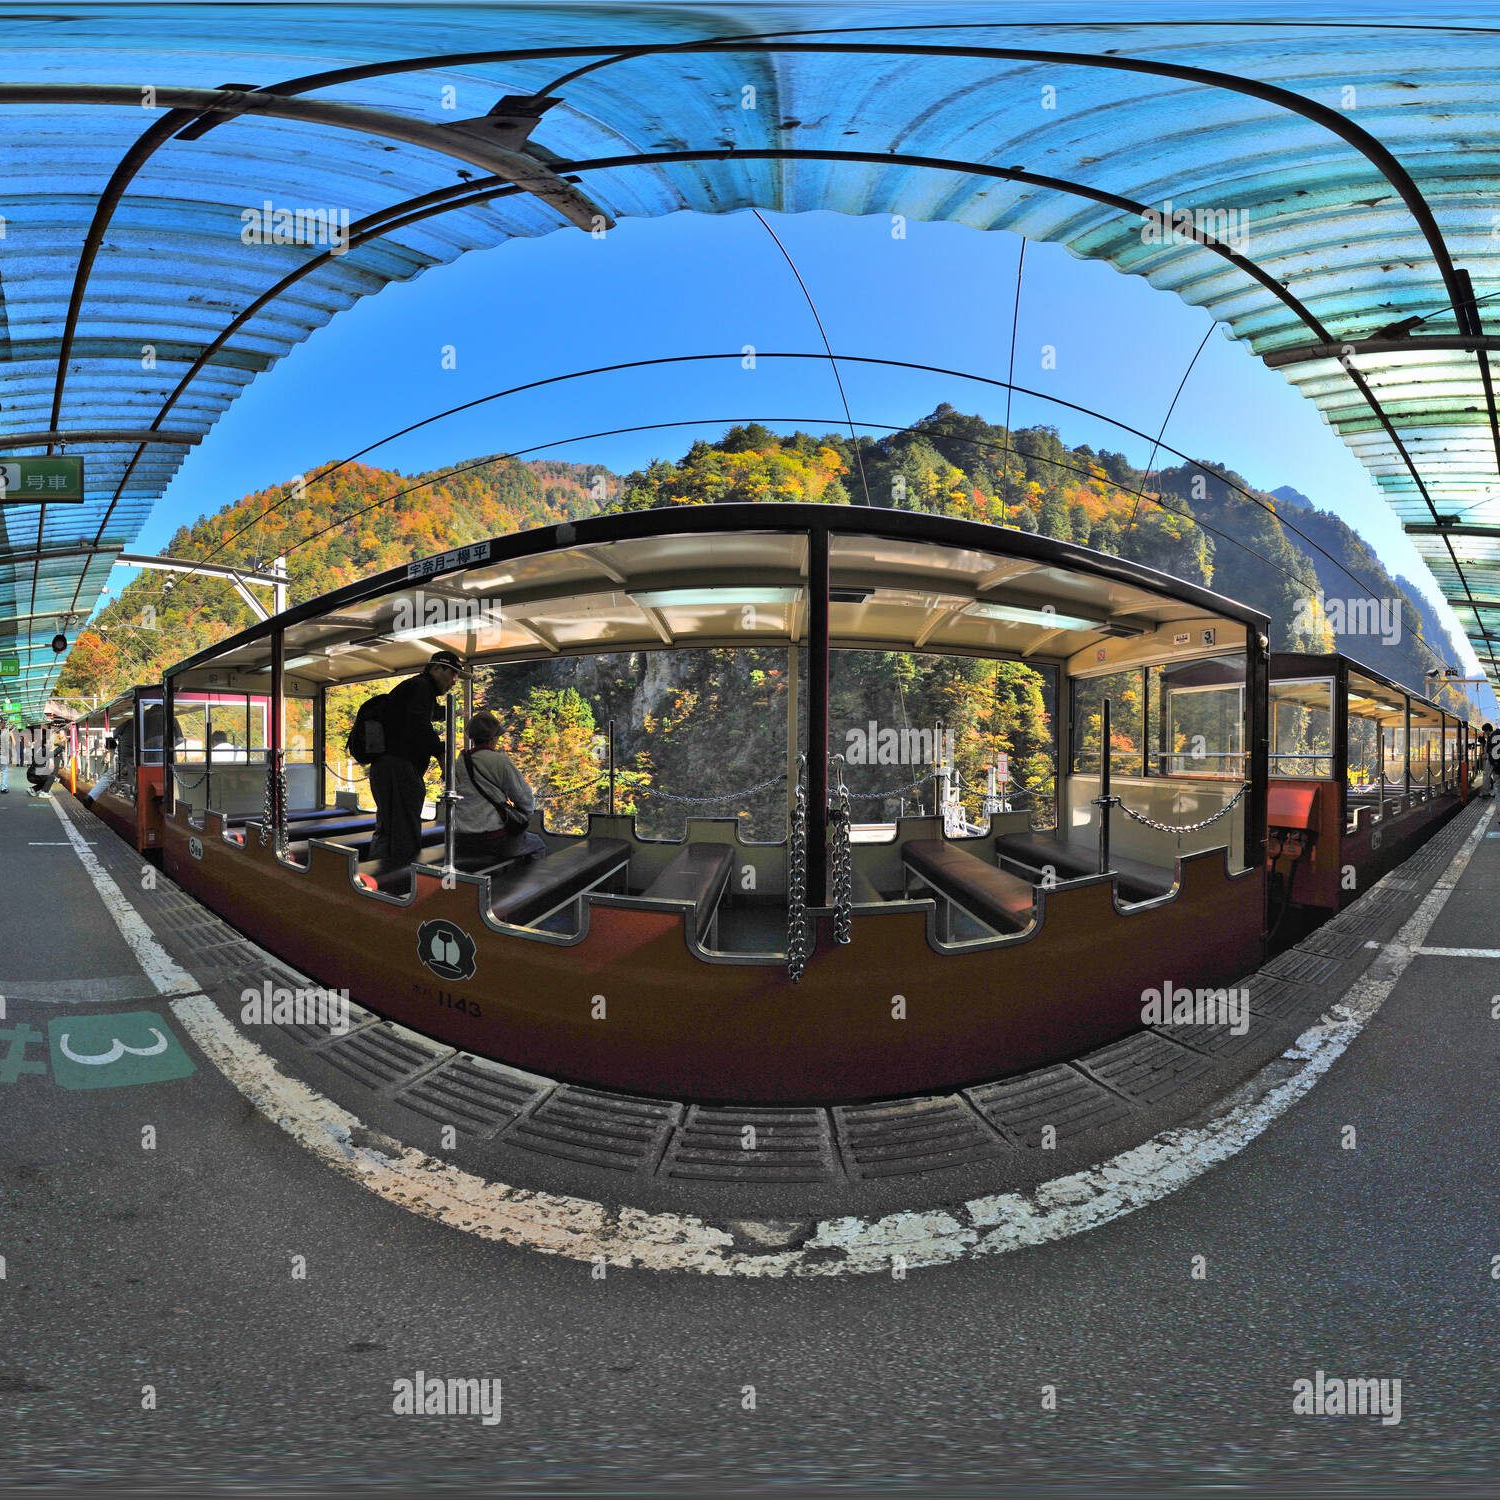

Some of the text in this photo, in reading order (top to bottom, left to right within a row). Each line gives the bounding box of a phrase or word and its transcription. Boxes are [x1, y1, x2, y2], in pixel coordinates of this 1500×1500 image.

[25, 475, 68, 490] 号車
[1204, 631, 1211, 641] 3
[438, 990, 482, 1017] 1143
[60, 1028, 168, 1065] 3
